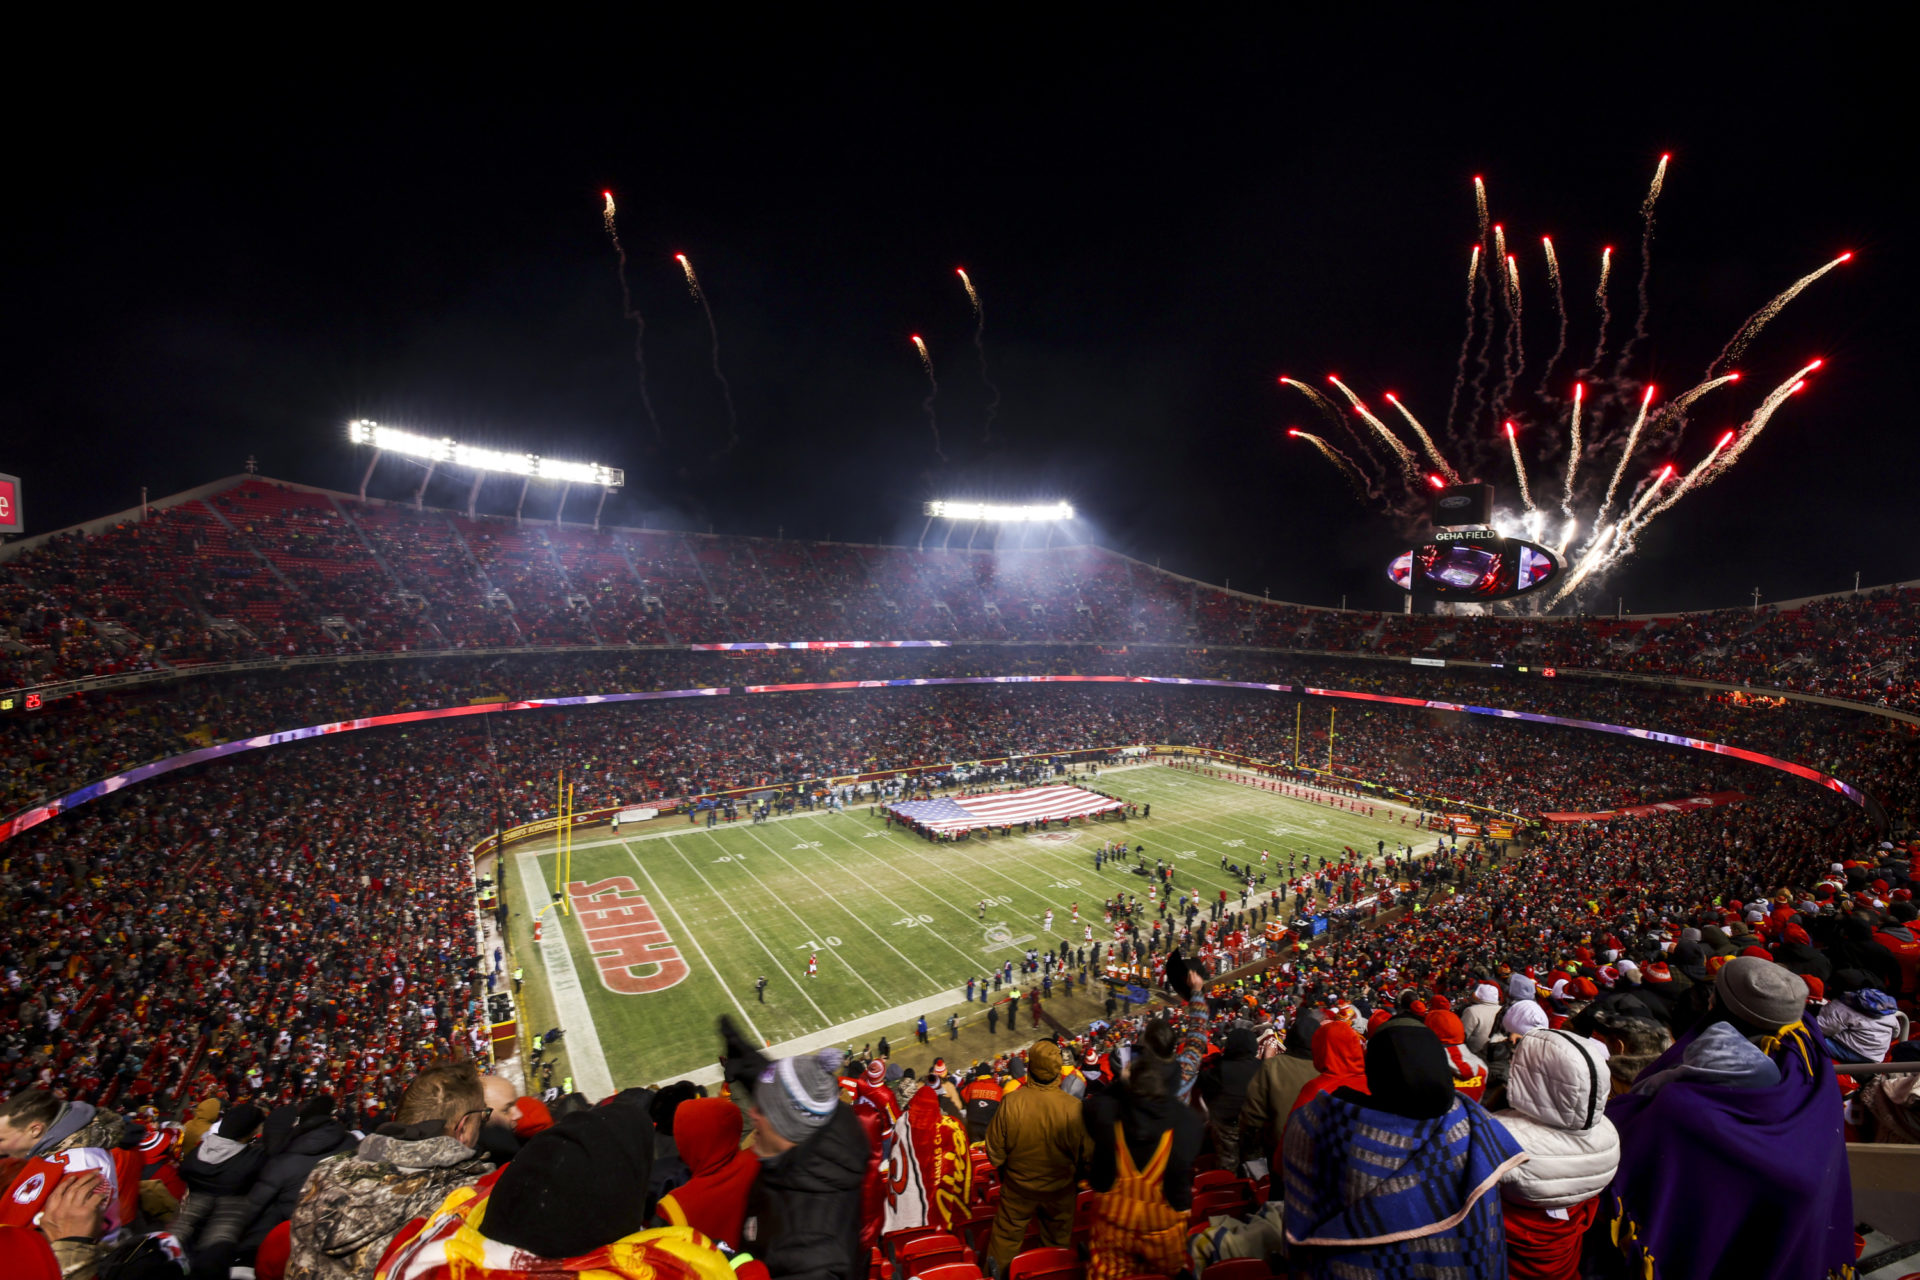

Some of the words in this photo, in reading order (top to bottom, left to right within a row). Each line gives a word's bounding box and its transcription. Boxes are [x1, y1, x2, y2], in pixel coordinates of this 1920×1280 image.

[1436, 532, 1464, 541] GEHA
[1466, 531, 1495, 539] FIELD
[1544, 668, 1554, 677] 25
[26, 694, 41, 708] 25
[901, 914, 934, 928] 20
[563, 876, 691, 995] CHIEFS
[806, 936, 842, 952] 10
[934, 1147, 943, 1186] KANSAS
